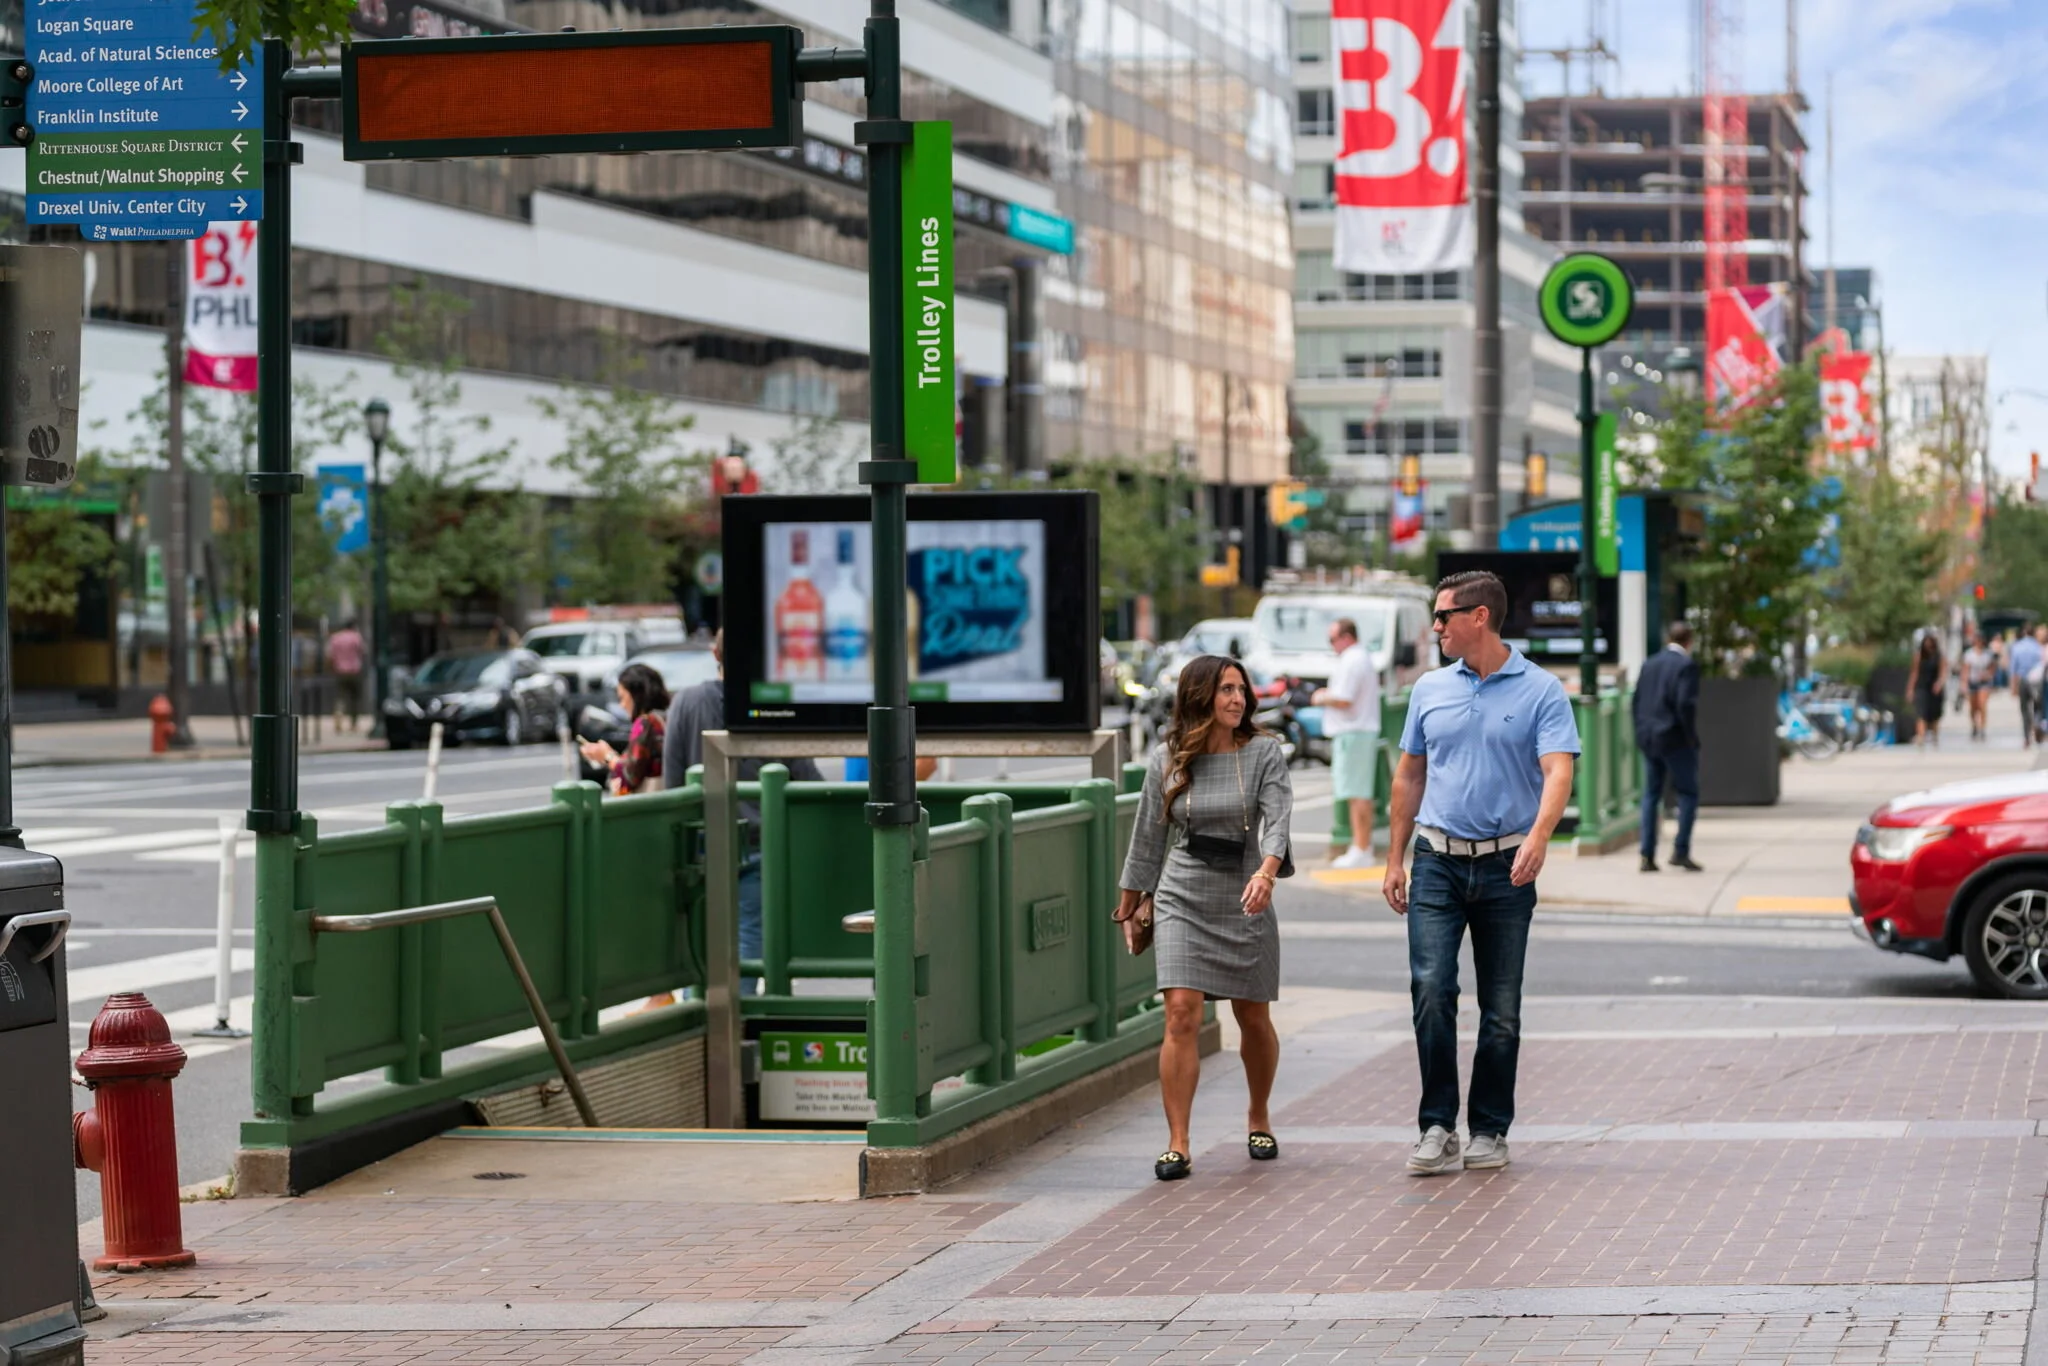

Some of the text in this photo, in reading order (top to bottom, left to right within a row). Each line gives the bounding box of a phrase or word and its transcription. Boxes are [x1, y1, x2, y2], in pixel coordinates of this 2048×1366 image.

[37, 17, 134, 36] Logan Square
[38, 45, 218, 63] Acad. of Natural Sciences
[38, 76, 183, 95] Moore College of Art
[38, 108, 159, 124] Franklin Institute
[38, 167, 225, 187] Chestnut/Walnut Shopping
[39, 198, 206, 217] Drexel Univ. Center City
[915, 216, 947, 389] Trolley Lines
[923, 547, 1027, 584] PICK
